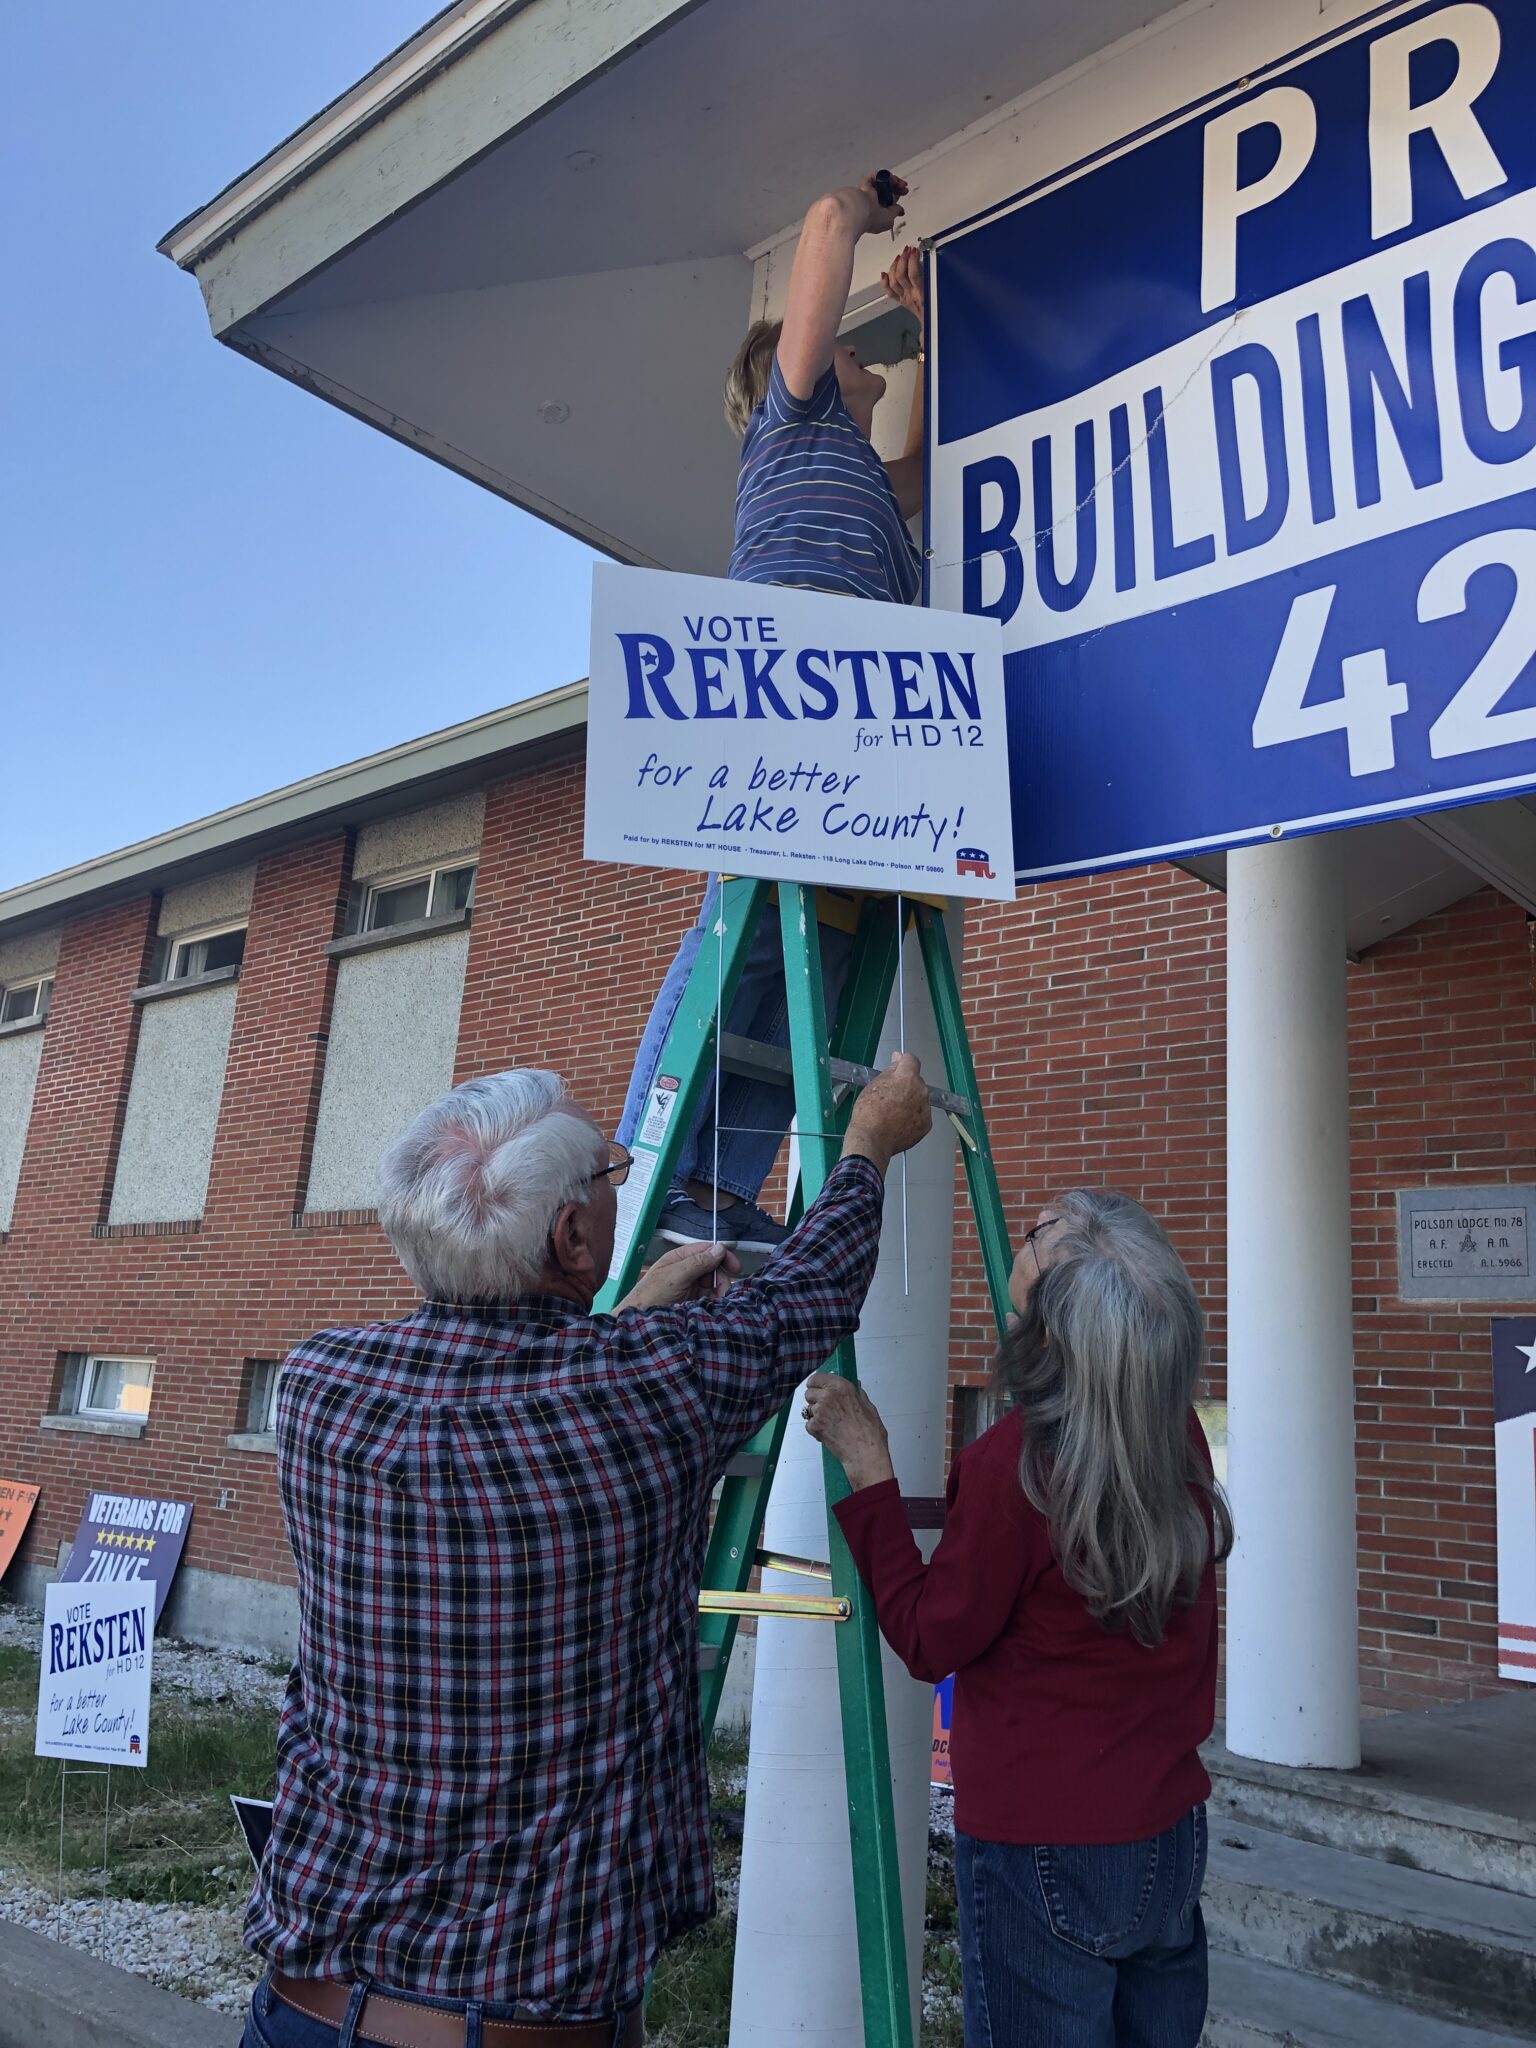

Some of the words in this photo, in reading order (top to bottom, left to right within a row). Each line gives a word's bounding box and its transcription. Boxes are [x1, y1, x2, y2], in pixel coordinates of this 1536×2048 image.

[962, 237, 1536, 627] BUILDING
[684, 616, 778, 642] VOTE
[615, 633, 982, 721] REKSTEN
[853, 727, 883, 752] for
[952, 725, 984, 747] 12
[637, 753, 694, 787] for
[708, 764, 728, 788] a
[748, 756, 861, 794] better
[696, 795, 799, 833] Lake
[822, 802, 965, 852] County!
[623, 834, 638, 842] Paid
[651, 836, 659, 844] by
[661, 838, 693, 847] REKSTEN
[718, 844, 741, 852] HOUSE
[790, 852, 816, 860] Reksten
[835, 856, 850, 865] Long
[852, 858, 867, 866] Lake
[869, 860, 885, 868] Drive
[1457, 1218, 1489, 1228] LODGE
[1511, 1217, 1523, 1227] 78
[1417, 1259, 1453, 1268] ERECTED
[88, 1494, 157, 1530] VETERANS
[154, 1501, 186, 1535] FOR
[79, 1549, 150, 1582] ZINKE
[67, 1602, 91, 1624] VOTE
[49, 1606, 146, 1675] REKSTEN
[49, 1693, 64, 1713] for
[66, 1695, 73, 1711] a
[76, 1688, 107, 1710] better
[62, 1712, 89, 1736] Lake
[94, 1708, 135, 1739] County!
